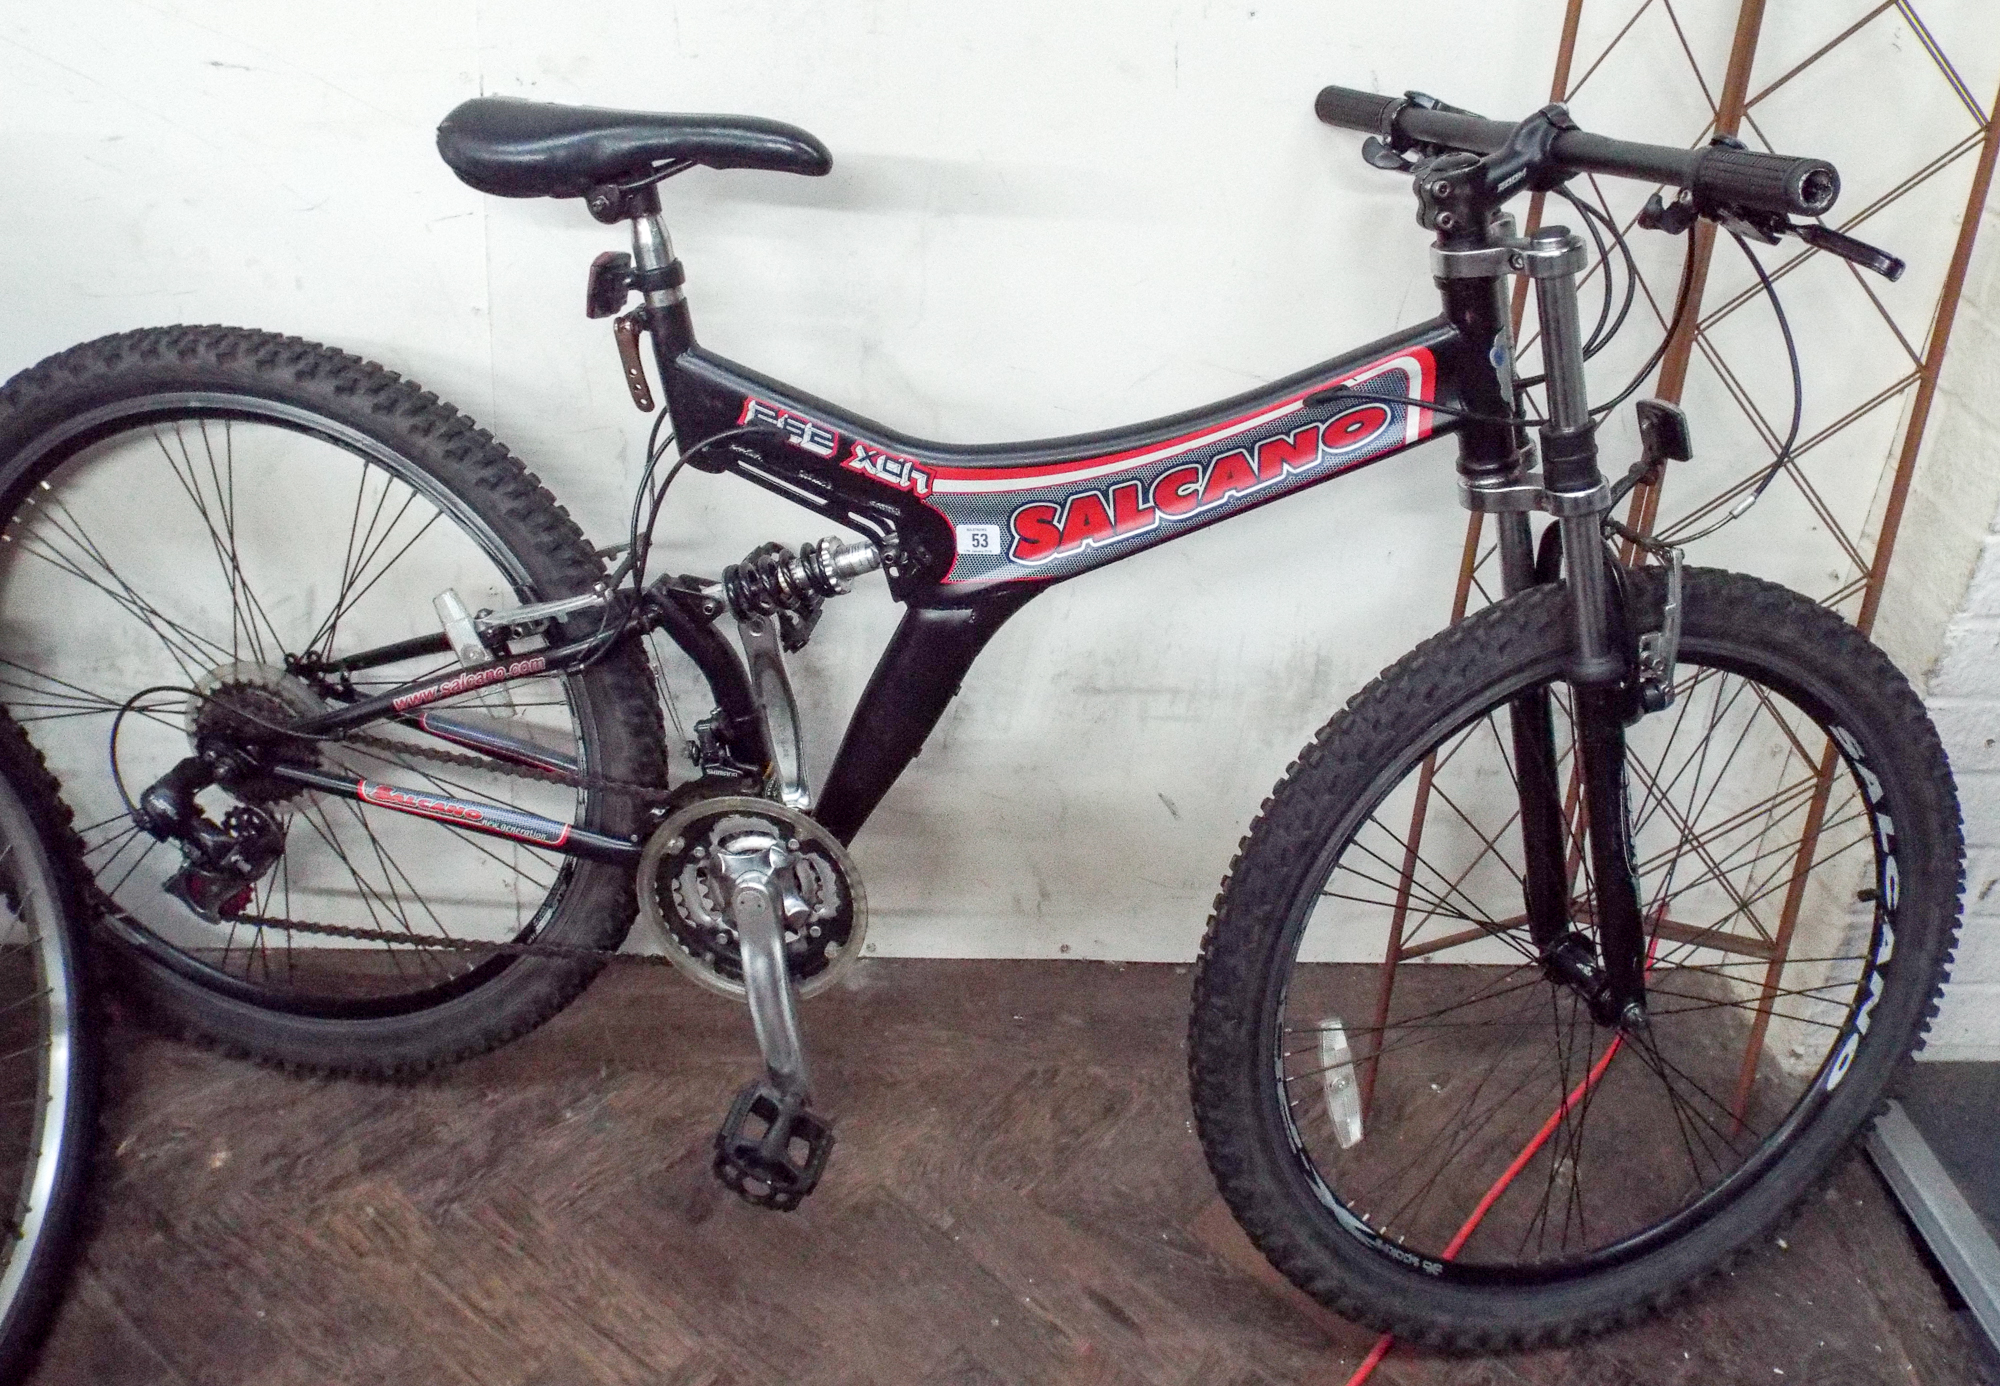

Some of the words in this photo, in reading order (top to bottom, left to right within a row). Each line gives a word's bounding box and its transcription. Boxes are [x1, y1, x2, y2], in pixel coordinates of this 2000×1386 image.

[1009, 402, 1393, 566] SALCANO
[971, 533, 989, 548] 53
[393, 655, 546, 712] www.salcano.com
[500, 823, 548, 842] generation
